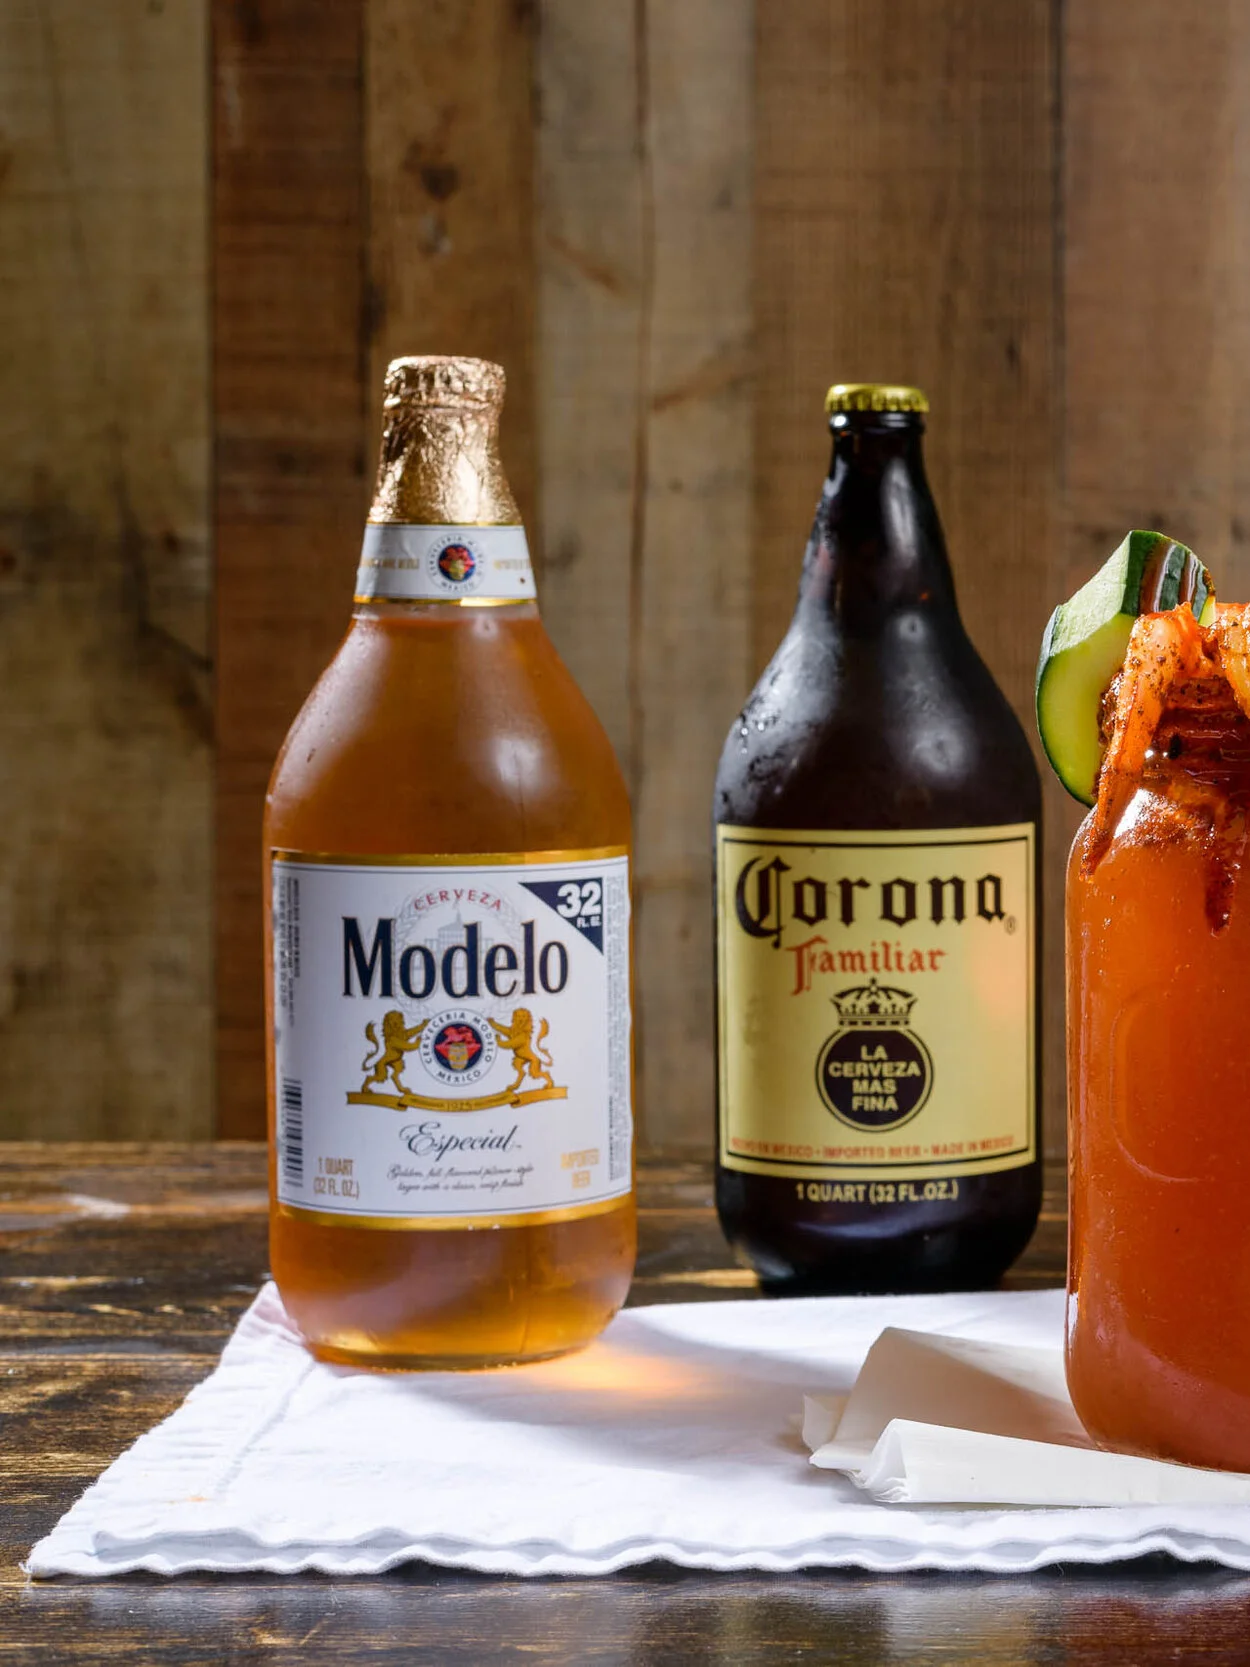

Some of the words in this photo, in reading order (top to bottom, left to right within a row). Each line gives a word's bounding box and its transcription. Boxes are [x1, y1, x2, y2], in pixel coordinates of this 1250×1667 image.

[414, 888, 502, 912] CERVEZA
[557, 881, 602, 919] 32
[736, 856, 1006, 949] Corona
[341, 916, 569, 999] Modelo
[785, 935, 948, 996] Familiar
[861, 1045, 888, 1061] LA
[437, 1069, 481, 1082] MEXICO
[828, 1061, 922, 1078] CERVEZA
[852, 1079, 897, 1094] MAS
[852, 1095, 899, 1112] FINA
[400, 1121, 518, 1162] Especial
[796, 1182, 804, 1200] 1
[806, 1182, 867, 1202] QUART
[869, 1183, 895, 1204] (32
